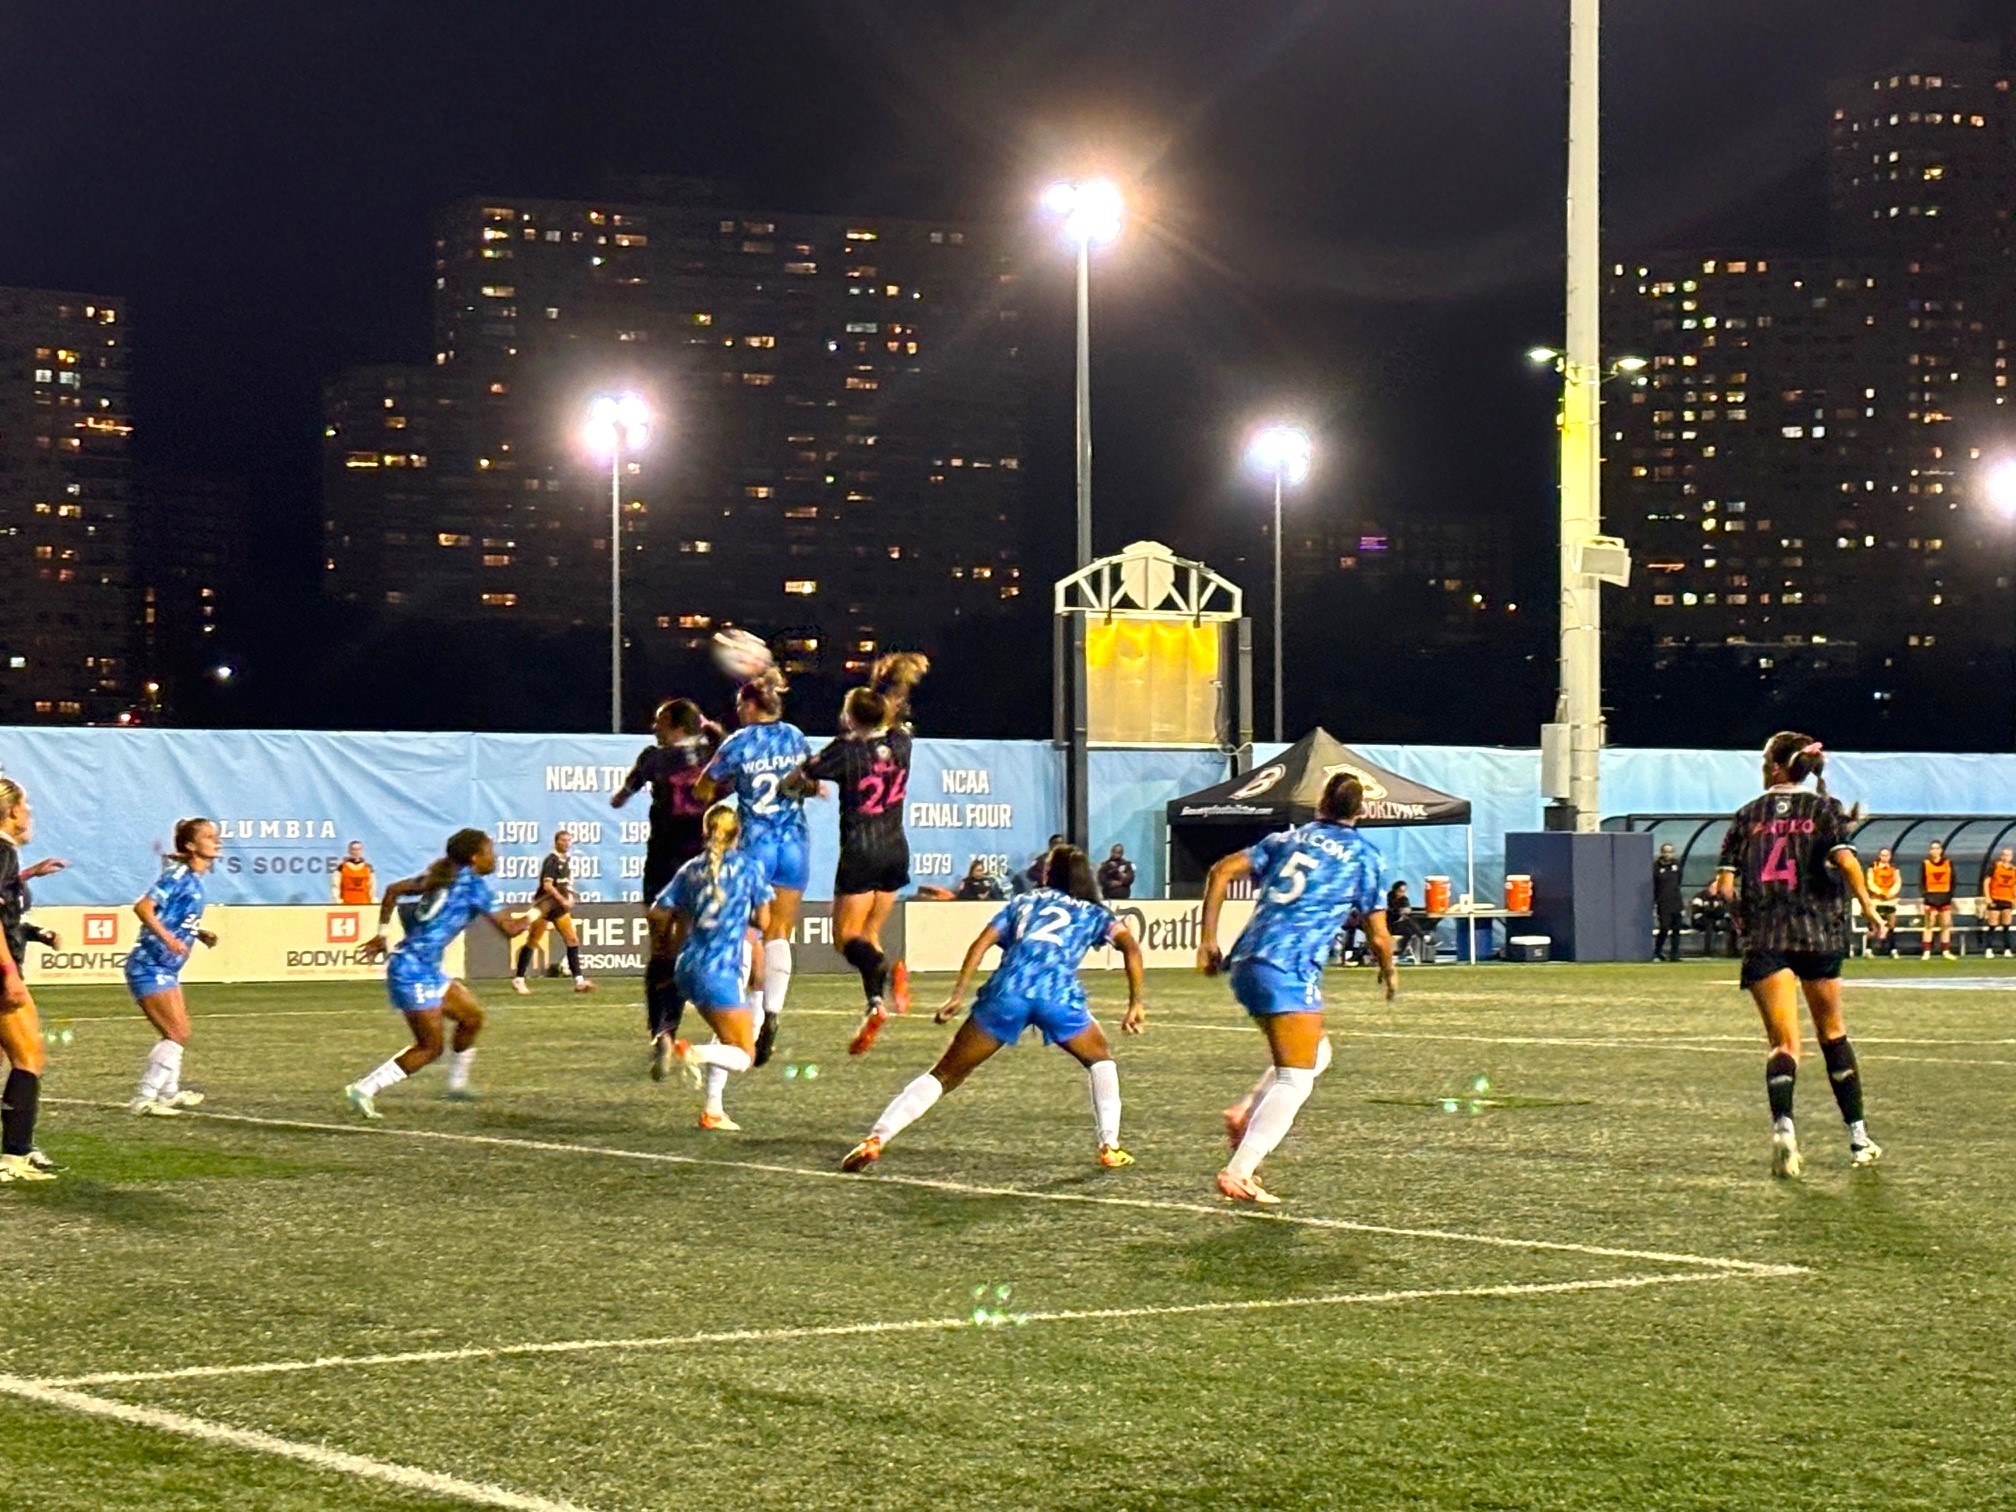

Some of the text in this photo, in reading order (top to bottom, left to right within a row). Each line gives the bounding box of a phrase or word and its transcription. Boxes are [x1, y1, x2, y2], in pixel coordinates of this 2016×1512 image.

[545, 766, 599, 792] NCAA
[941, 769, 990, 794] NCAA
[909, 802, 1012, 828] FINAL FOUR
[218, 820, 337, 839] LUMBIA
[496, 821, 539, 843] 1970
[619, 821, 652, 843] 198
[253, 856, 339, 875] SOCCE
[497, 856, 540, 878] 1978
[569, 856, 602, 878] 981
[913, 853, 952, 875] 1979
[1761, 836, 1798, 891] 4
[1268, 851, 1320, 904] 5
[1016, 903, 1073, 947] 12
[577, 952, 647, 970] ERSONAL
